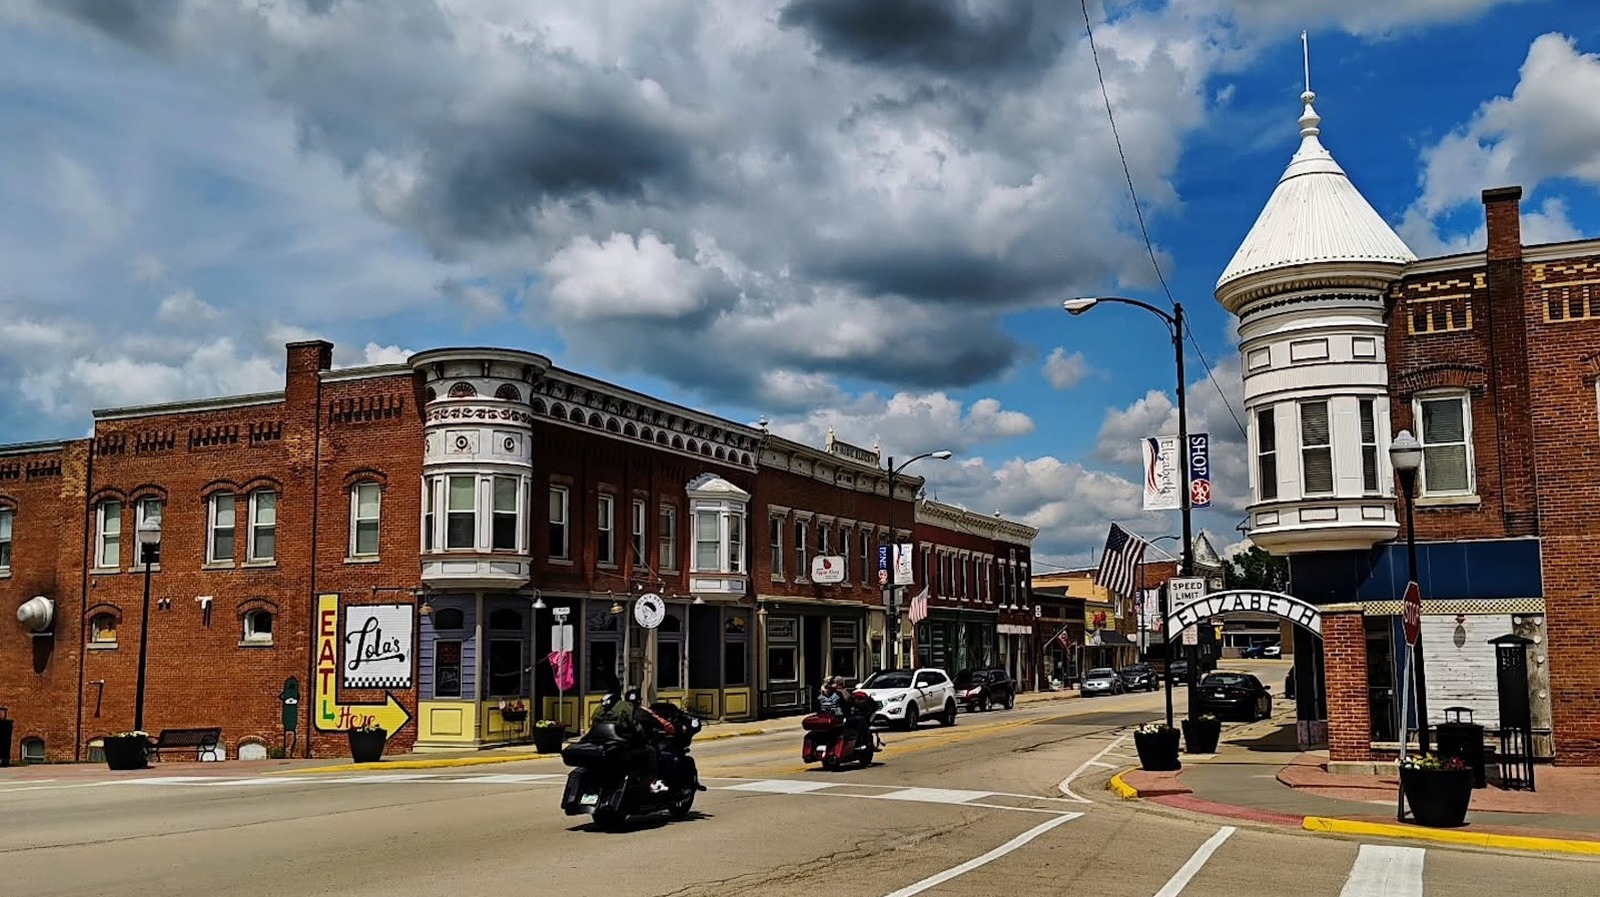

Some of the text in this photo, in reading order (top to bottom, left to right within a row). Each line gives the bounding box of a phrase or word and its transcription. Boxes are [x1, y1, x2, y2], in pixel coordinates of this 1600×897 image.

[1161, 440, 1177, 494] Elizabeth
[1191, 436, 1207, 476] SHOP
[1172, 582, 1203, 591] SPEED
[1175, 592, 1200, 600] LIMIT
[1176, 593, 1315, 628] ELIZABETH
[1404, 601, 1420, 627] STOP
[345, 616, 405, 671] Lola's
[335, 706, 376, 729] Here
